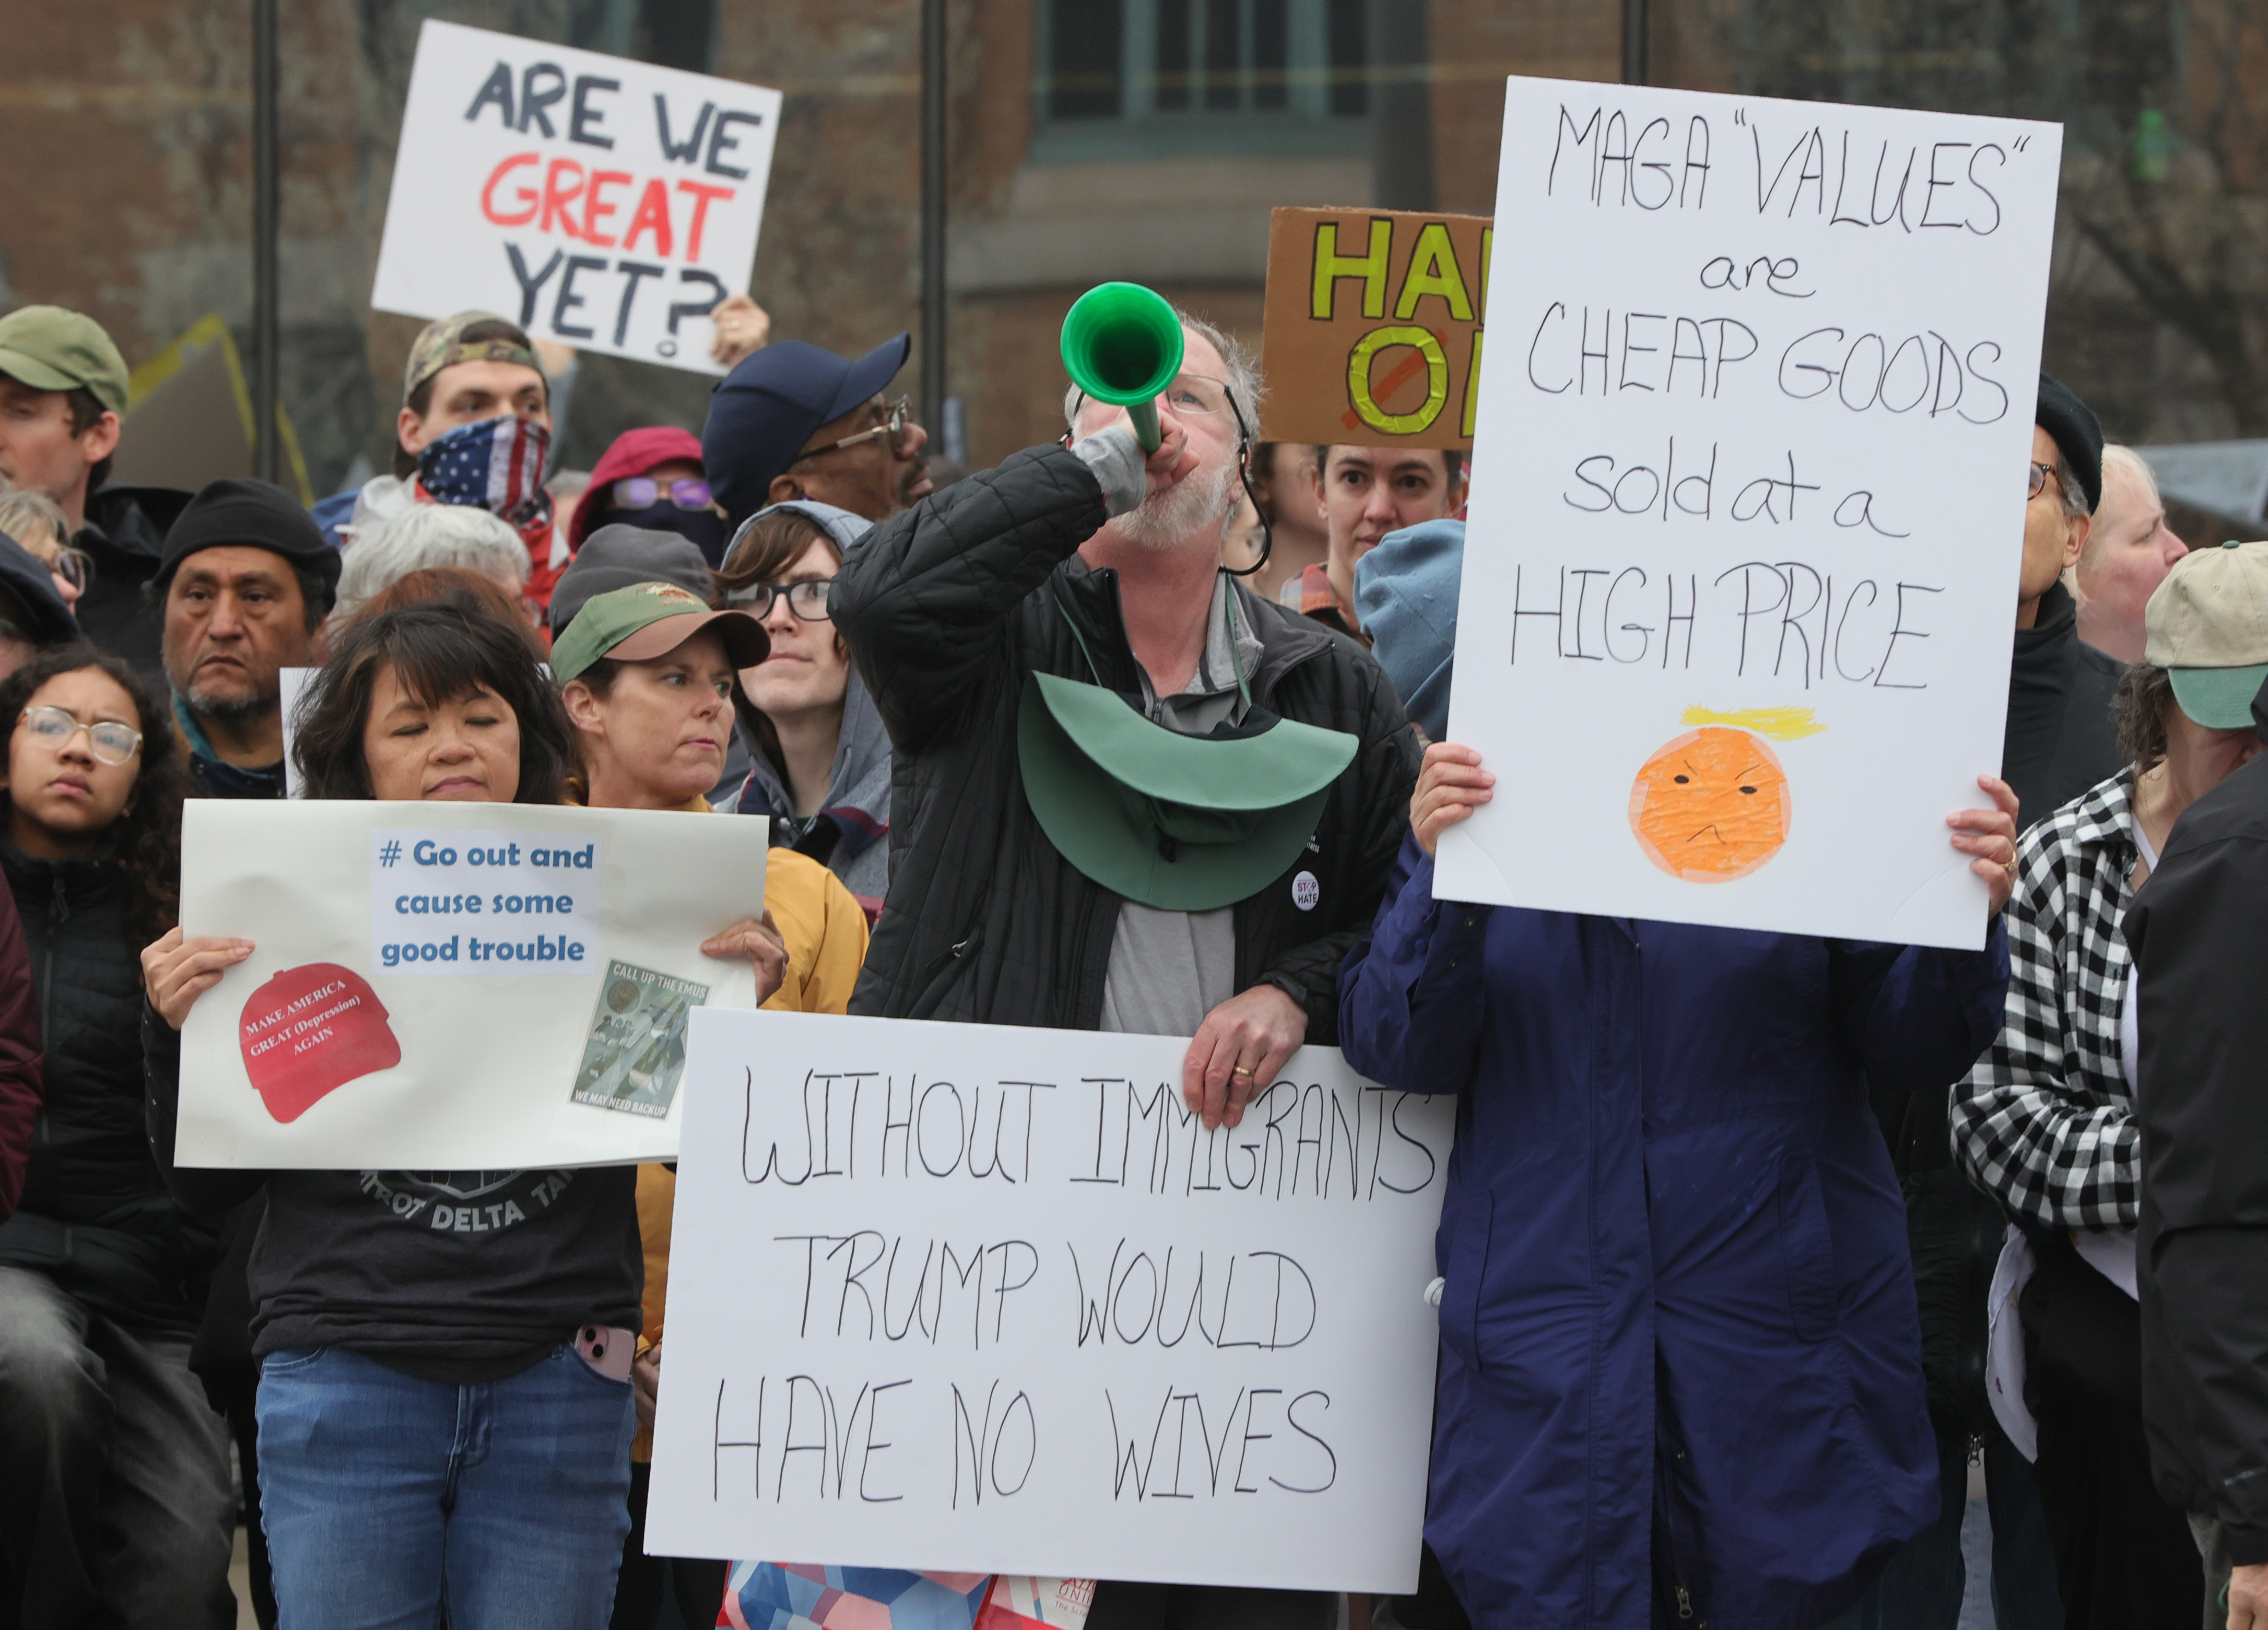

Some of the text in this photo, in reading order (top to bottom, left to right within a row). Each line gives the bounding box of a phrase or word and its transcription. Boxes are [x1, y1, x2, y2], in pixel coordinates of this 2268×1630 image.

[464, 59, 762, 181] ARE WE
[1548, 103, 1710, 210] MAGA
[481, 152, 736, 264] GREAT
[503, 242, 729, 358] YET?
[1309, 216, 1494, 326] HA
[1700, 255, 1816, 298] are
[1529, 302, 2008, 424] CHEAP GOODS
[1731, 450, 1821, 524] at
[1834, 490, 1911, 538] a
[1511, 562, 1946, 690] HIGH PRICE
[380, 840, 594, 869] # Go out and
[395, 894, 573, 914] cause some
[1297, 881, 1317, 893] STOP
[1298, 893, 1317, 905] HATE
[381, 934, 585, 966] good trouble
[613, 963, 707, 999] CALL UP THE EMUS
[245, 979, 346, 1037] MAKE AMERICA
[250, 994, 361, 1057] GREAT (Depression)
[293, 1026, 334, 1056] AGAIN
[575, 1089, 667, 1117] WE MAY NEED BACKUP
[741, 1065, 1057, 1185] WITHOUT
[431, 1199, 526, 1233] DELTA
[774, 1230, 1316, 1351] TRUMP WOULD
[713, 1374, 1337, 1510] HAVE NO WIVES
